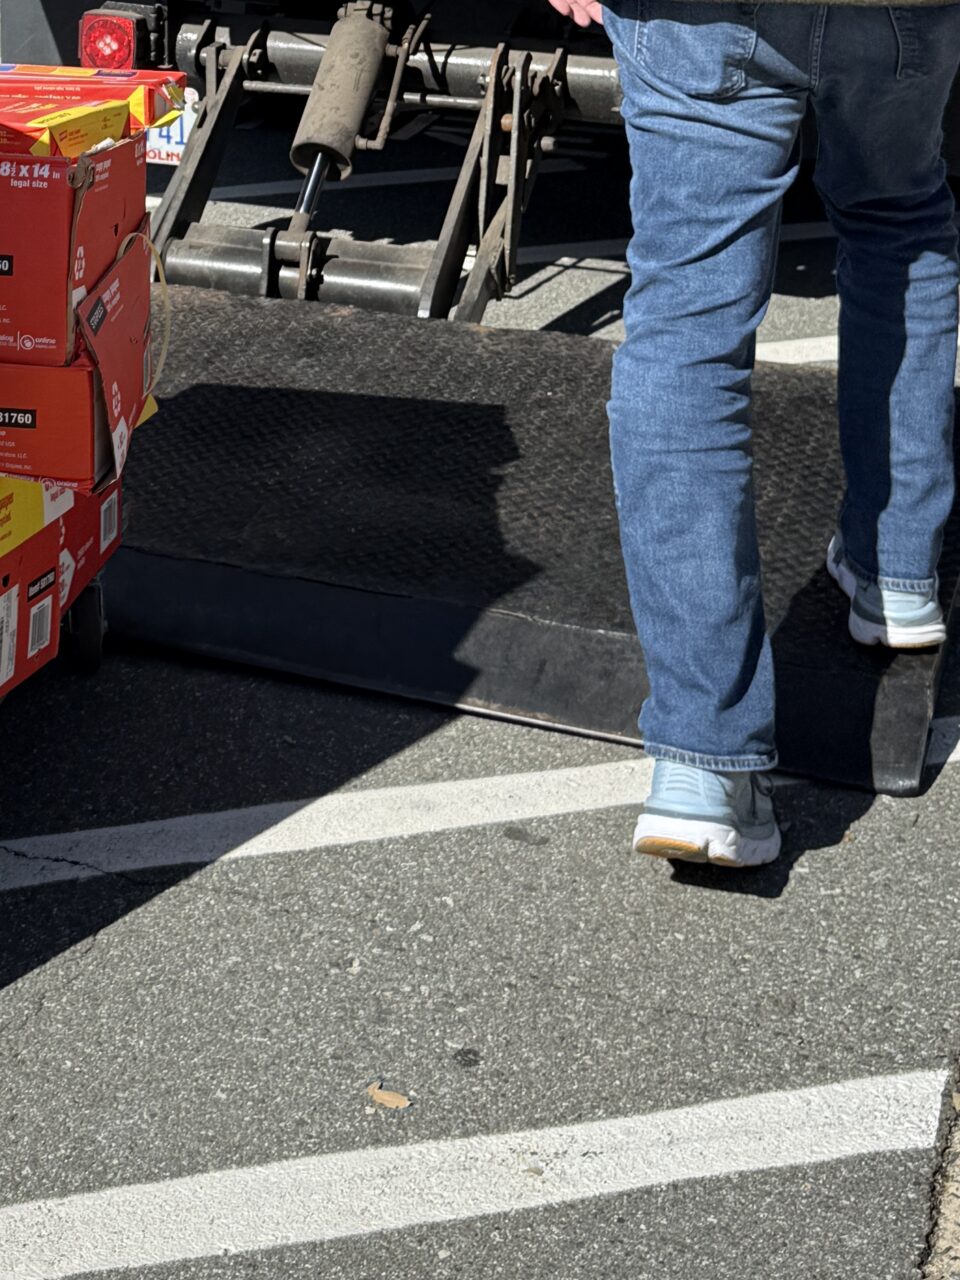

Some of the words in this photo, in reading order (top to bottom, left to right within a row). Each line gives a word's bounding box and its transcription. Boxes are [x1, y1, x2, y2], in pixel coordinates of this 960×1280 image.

[147, 149, 181, 161] OLIN
[32, 163, 50, 179] 14
[11, 178, 30, 189] legal
[31, 180, 48, 189] size
